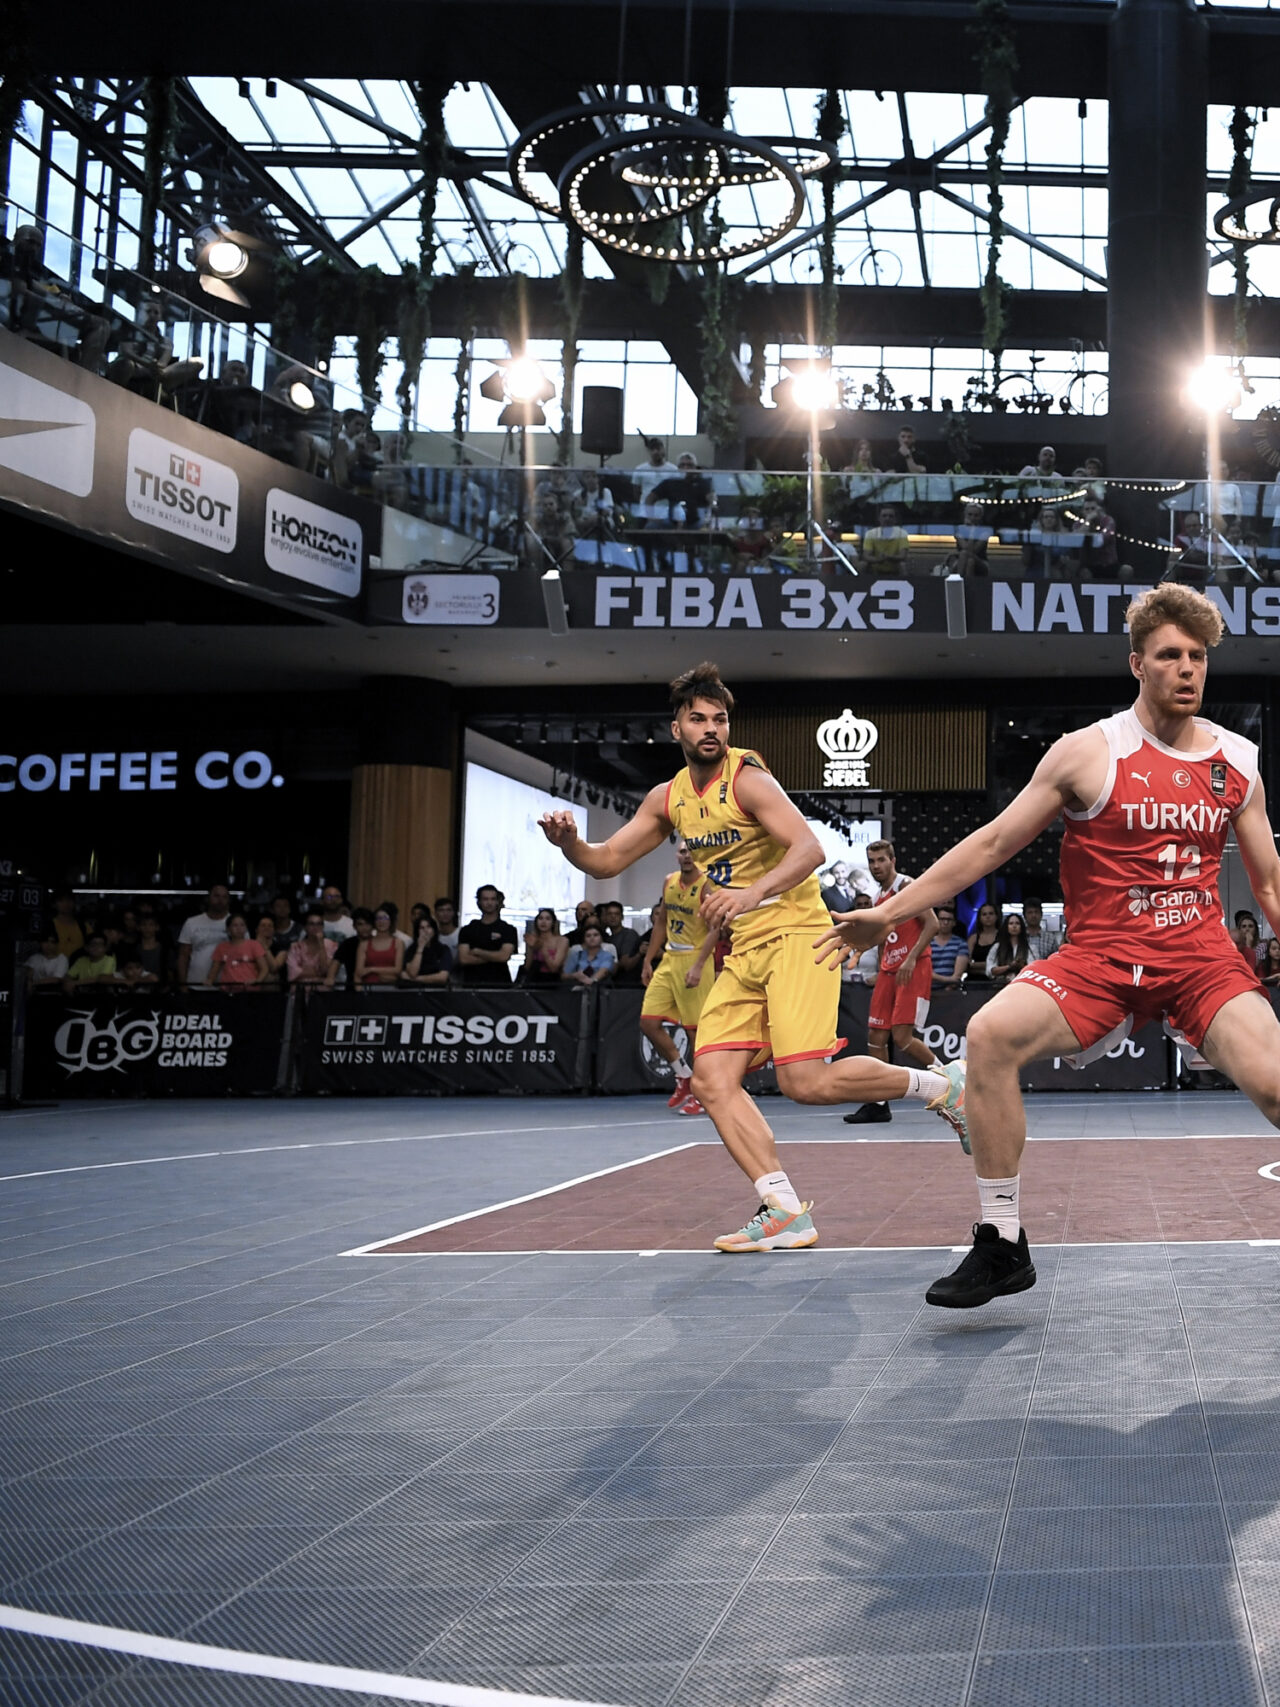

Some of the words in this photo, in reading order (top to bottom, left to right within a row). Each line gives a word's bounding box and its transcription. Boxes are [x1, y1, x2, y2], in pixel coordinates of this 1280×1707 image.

[134, 467, 231, 527] TISSOT
[272, 510, 357, 564] HORIZON
[482, 593, 496, 618] 3
[595, 576, 763, 628] FIBA
[781, 578, 914, 629] 3x3
[195, 750, 284, 789] CO.
[1158, 843, 1201, 881] 12
[1155, 905, 1203, 928] BBVA
[165, 1015, 222, 1030] IDEAL
[392, 1015, 559, 1045] TISSOT
[161, 1033, 232, 1049] BOARD
[158, 1051, 227, 1067] GAMES
[322, 1050, 375, 1064] SWISS
[382, 1050, 458, 1063] WATCHES
[465, 1050, 513, 1063] SINCE
[522, 1050, 556, 1063] 1853
